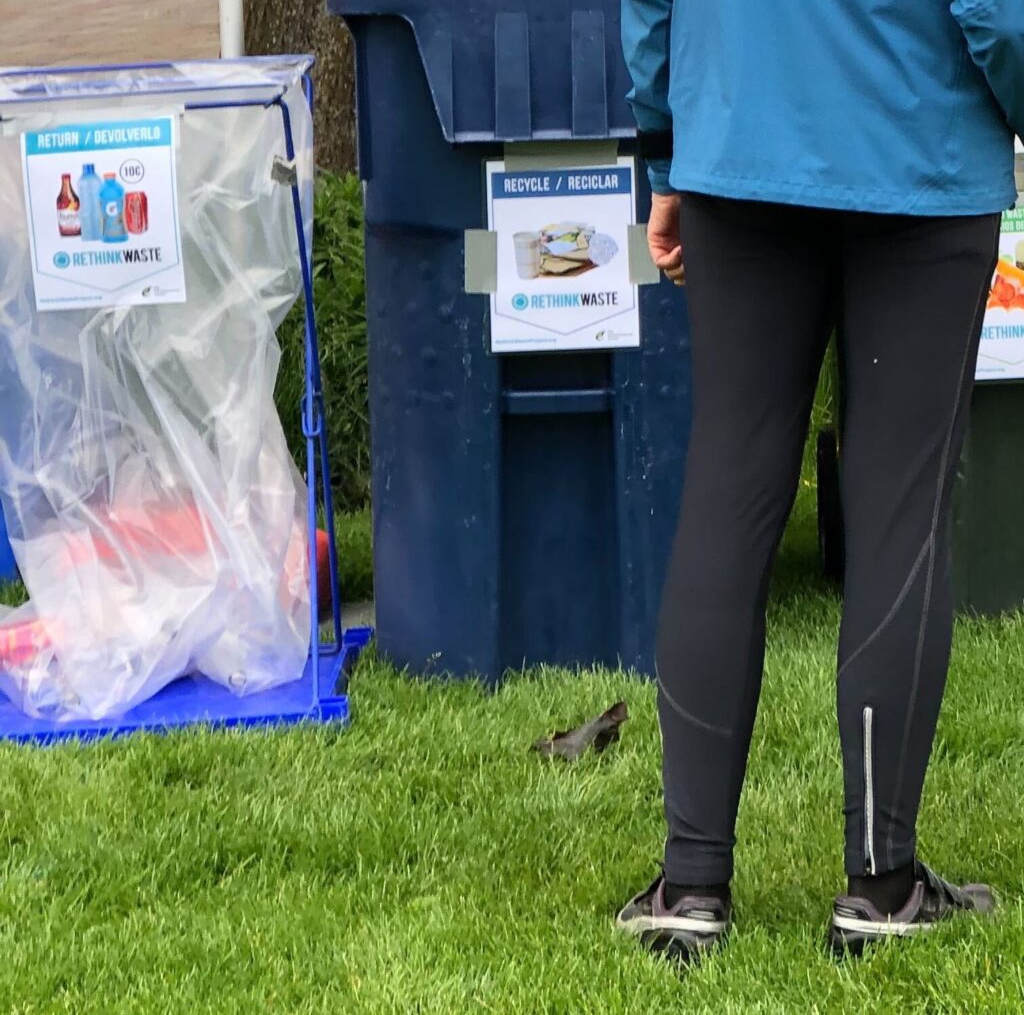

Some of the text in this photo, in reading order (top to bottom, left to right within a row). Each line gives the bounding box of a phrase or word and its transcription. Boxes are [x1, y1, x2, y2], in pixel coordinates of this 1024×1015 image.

[37, 131, 79, 148] RETURN
[94, 126, 161, 144] DEVOLVERLO
[504, 177, 550, 193] RECYCLE
[568, 174, 618, 191] RECICLAR
[1015, 220, 1024, 231] DE
